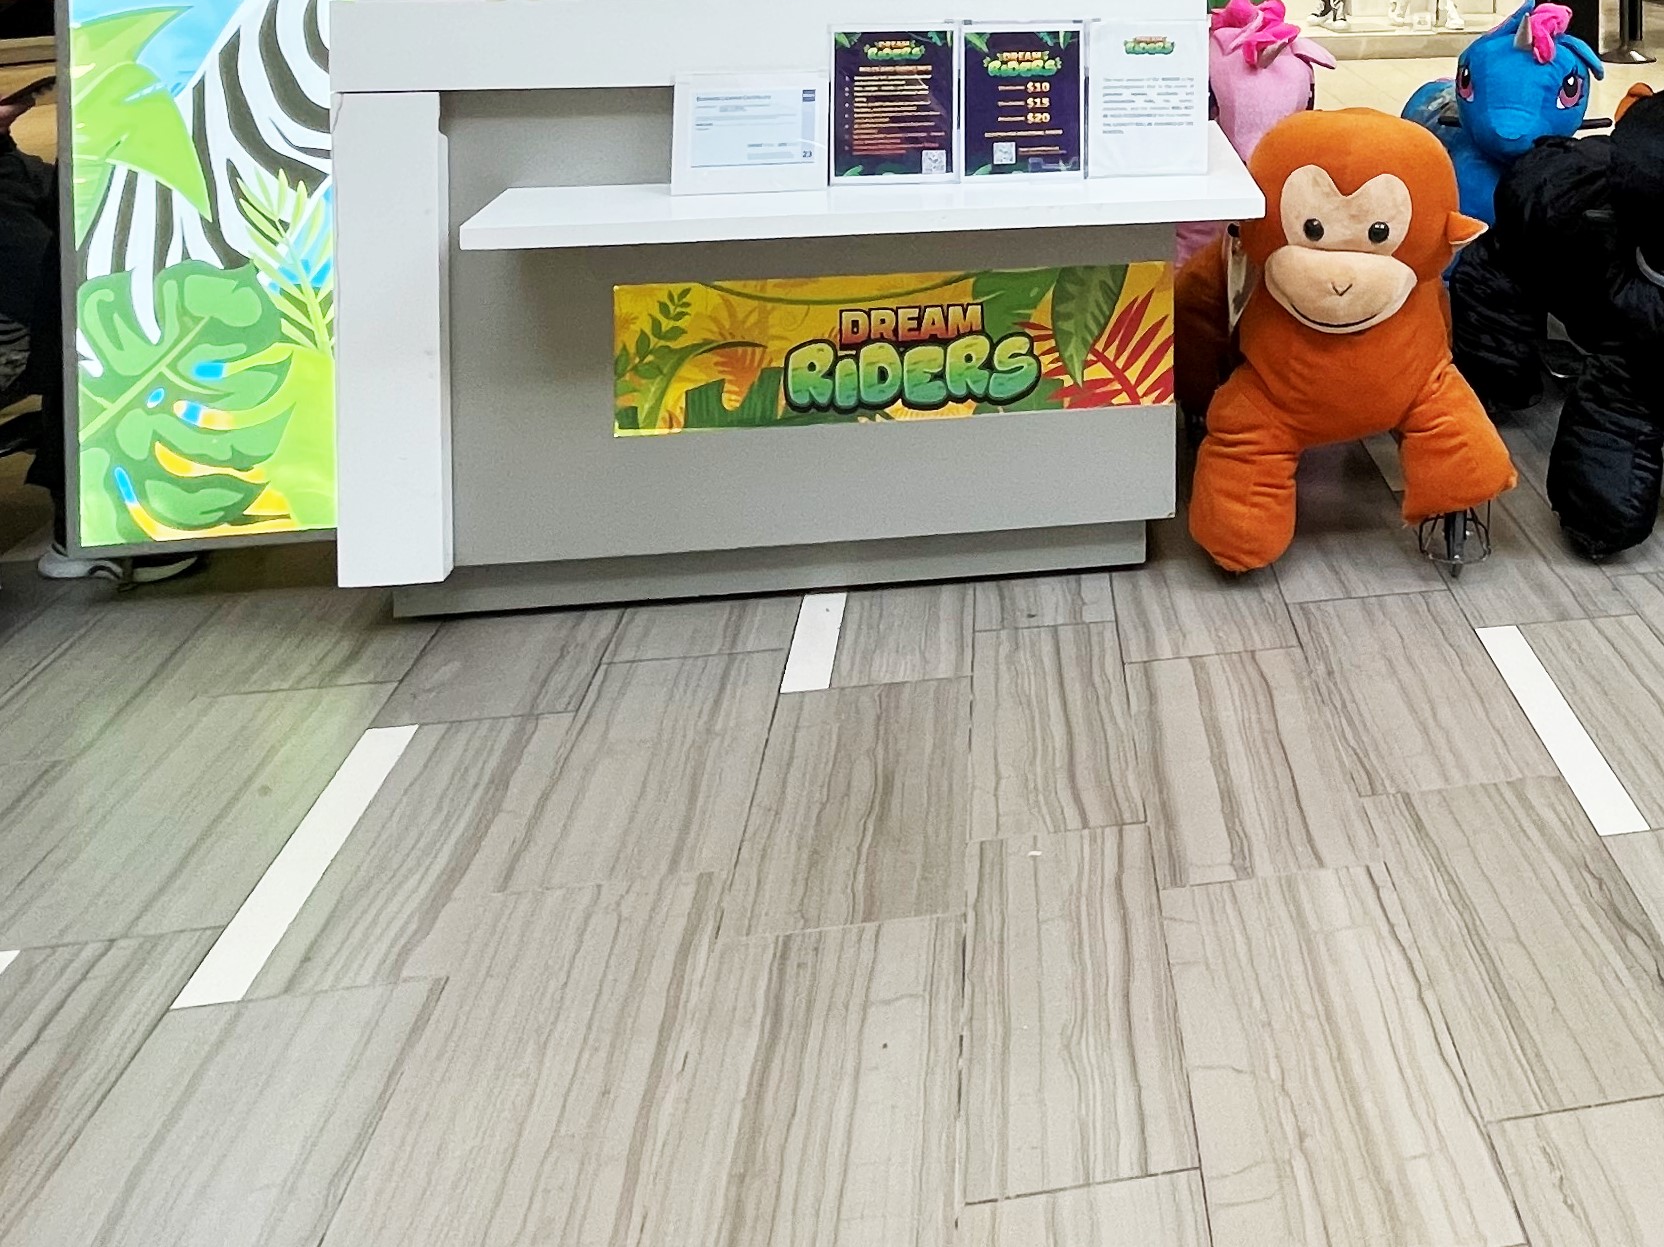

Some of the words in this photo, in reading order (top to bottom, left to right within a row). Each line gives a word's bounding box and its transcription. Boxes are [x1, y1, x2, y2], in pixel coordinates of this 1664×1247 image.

[1026, 81, 1051, 93] $10
[1026, 112, 1051, 124] $20
[839, 303, 985, 347] DREAM
